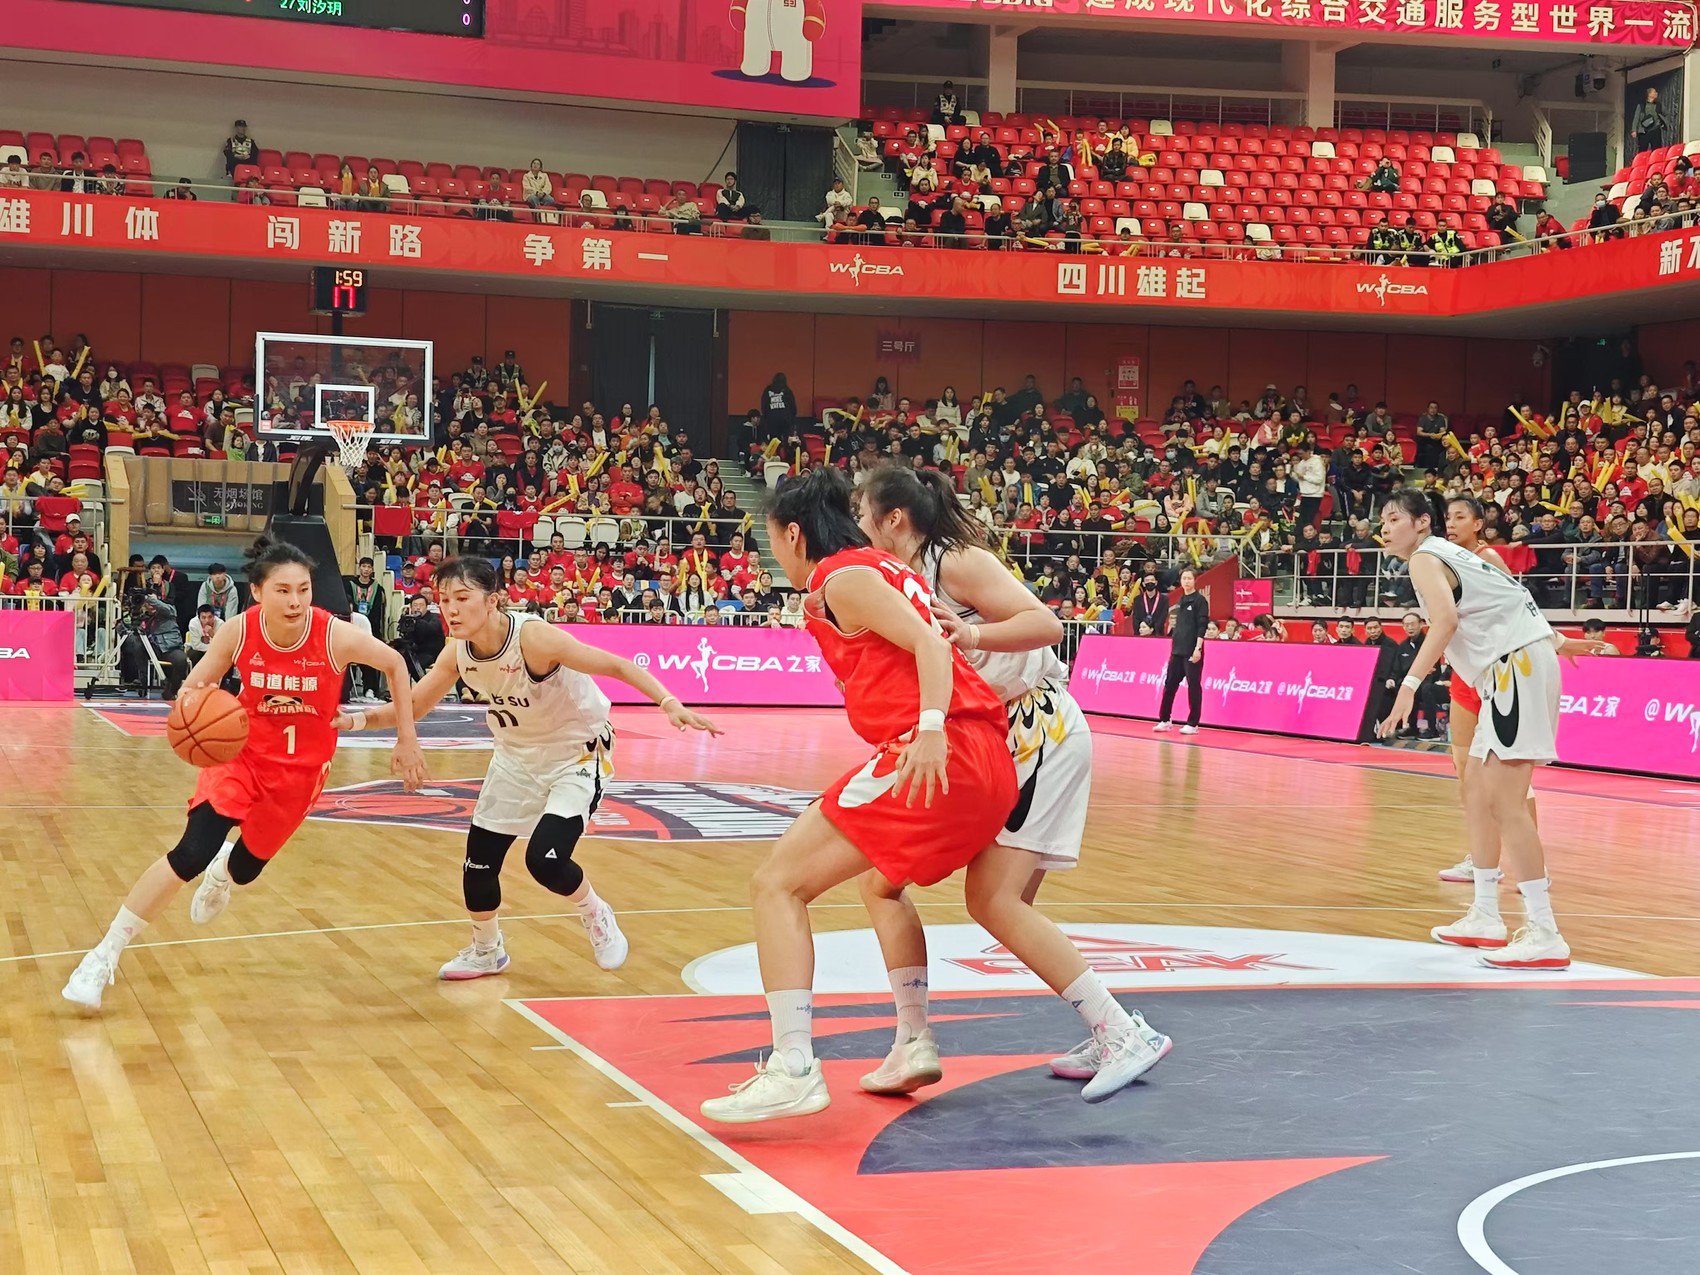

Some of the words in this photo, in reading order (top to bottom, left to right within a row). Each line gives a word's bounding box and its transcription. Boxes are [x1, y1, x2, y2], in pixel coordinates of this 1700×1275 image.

[462, 13, 471, 26] 0
[267, 215, 422, 258] 闯新路
[523, 233, 668, 271] 争第一
[829, 260, 904, 278] WCBA
[335, 270, 363, 287] 1:59
[1058, 262, 1206, 299] 四川雄起
[334, 286, 354, 309] 17
[1355, 281, 1428, 298] WCBA
[882, 340, 915, 352] 三号厅
[213, 487, 264, 500] 无烟场馆
[250, 671, 318, 692] 蜀道能源
[283, 725, 296, 755] 1
